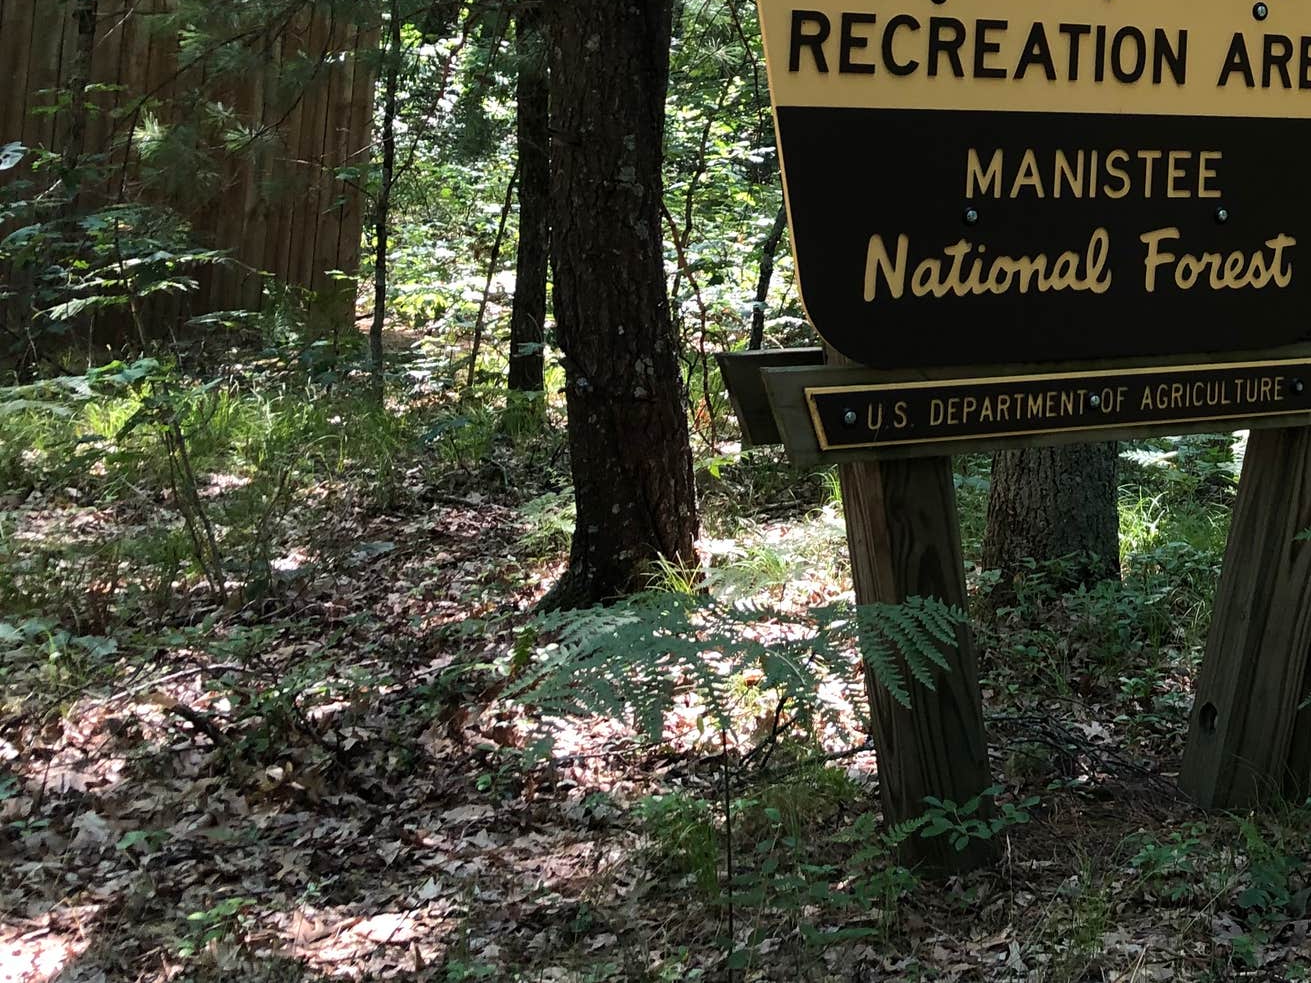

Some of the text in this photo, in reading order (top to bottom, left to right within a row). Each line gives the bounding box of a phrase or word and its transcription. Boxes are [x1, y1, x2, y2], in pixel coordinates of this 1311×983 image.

[788, 9, 1188, 86] RECREATION
[964, 147, 1223, 200] MANISTEE
[863, 227, 1112, 303] National
[1139, 227, 1297, 293] Forest
[867, 376, 1285, 430] U.S. DEPARTMENT OF AGRICULTURE
